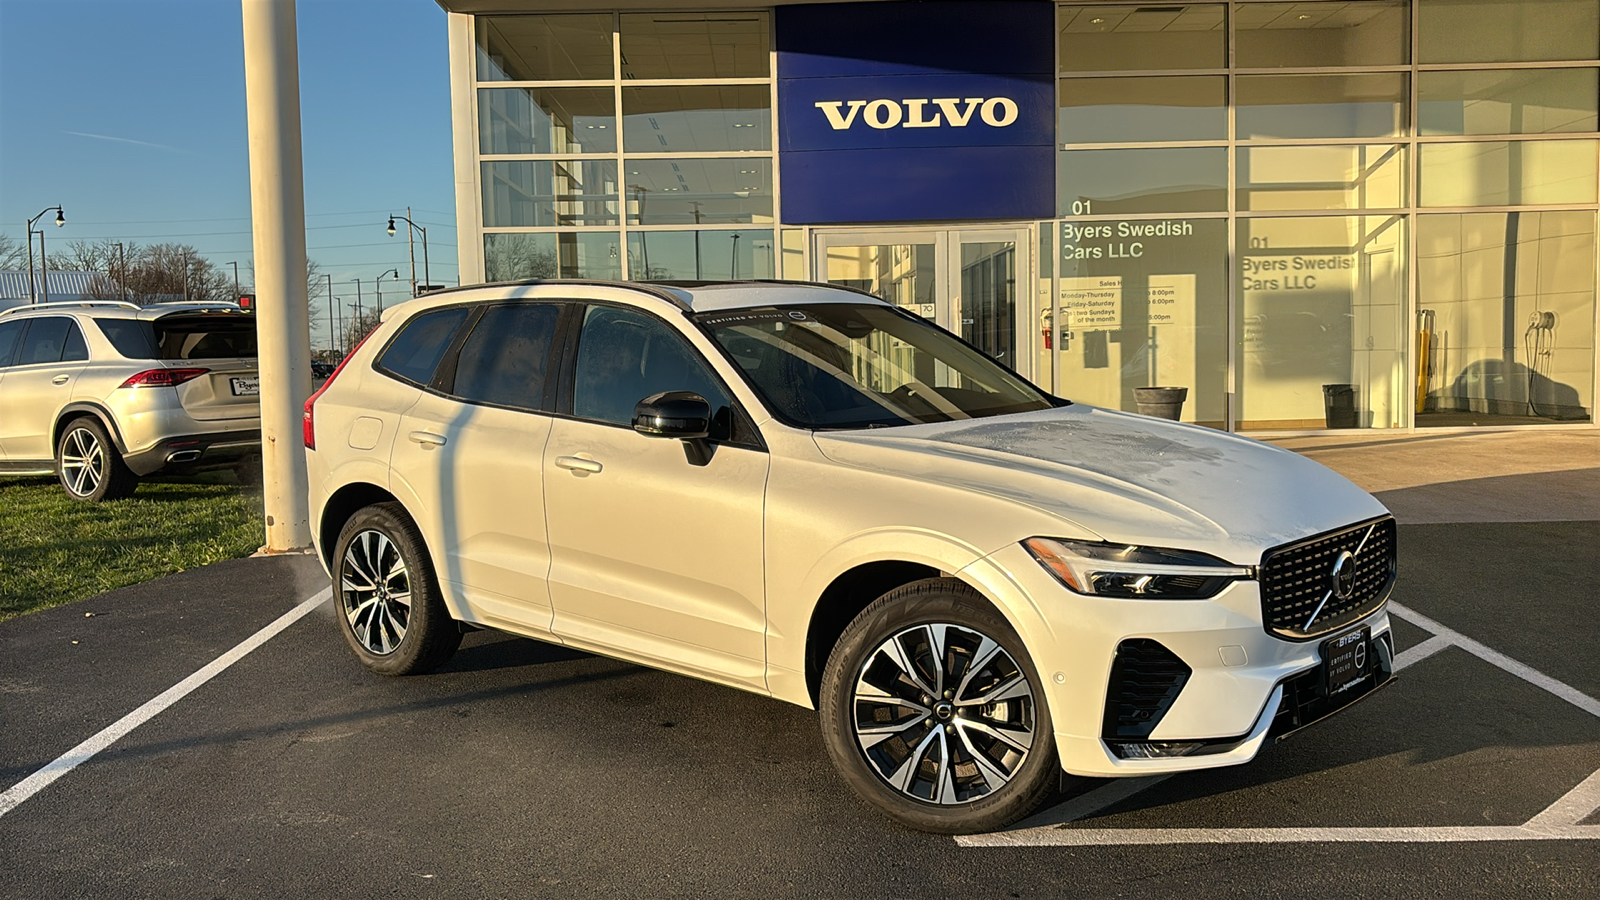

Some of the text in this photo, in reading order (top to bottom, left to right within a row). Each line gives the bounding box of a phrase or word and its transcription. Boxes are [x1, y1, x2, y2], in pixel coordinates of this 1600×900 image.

[815, 97, 1018, 130] VOLVO
[1064, 221, 1193, 242] Byers Swedish
[1063, 242, 1143, 260] Cars LLC
[1242, 258, 1288, 275] Byers
[1242, 275, 1316, 291] Cars LLC
[1061, 292, 1115, 300] Monday-Thursday
[1067, 300, 1115, 308] Friday-Saturday
[706, 315, 746, 325] CERTIFIED
[1089, 308, 1115, 316] Sundays
[1338, 630, 1362, 648] BYERS
